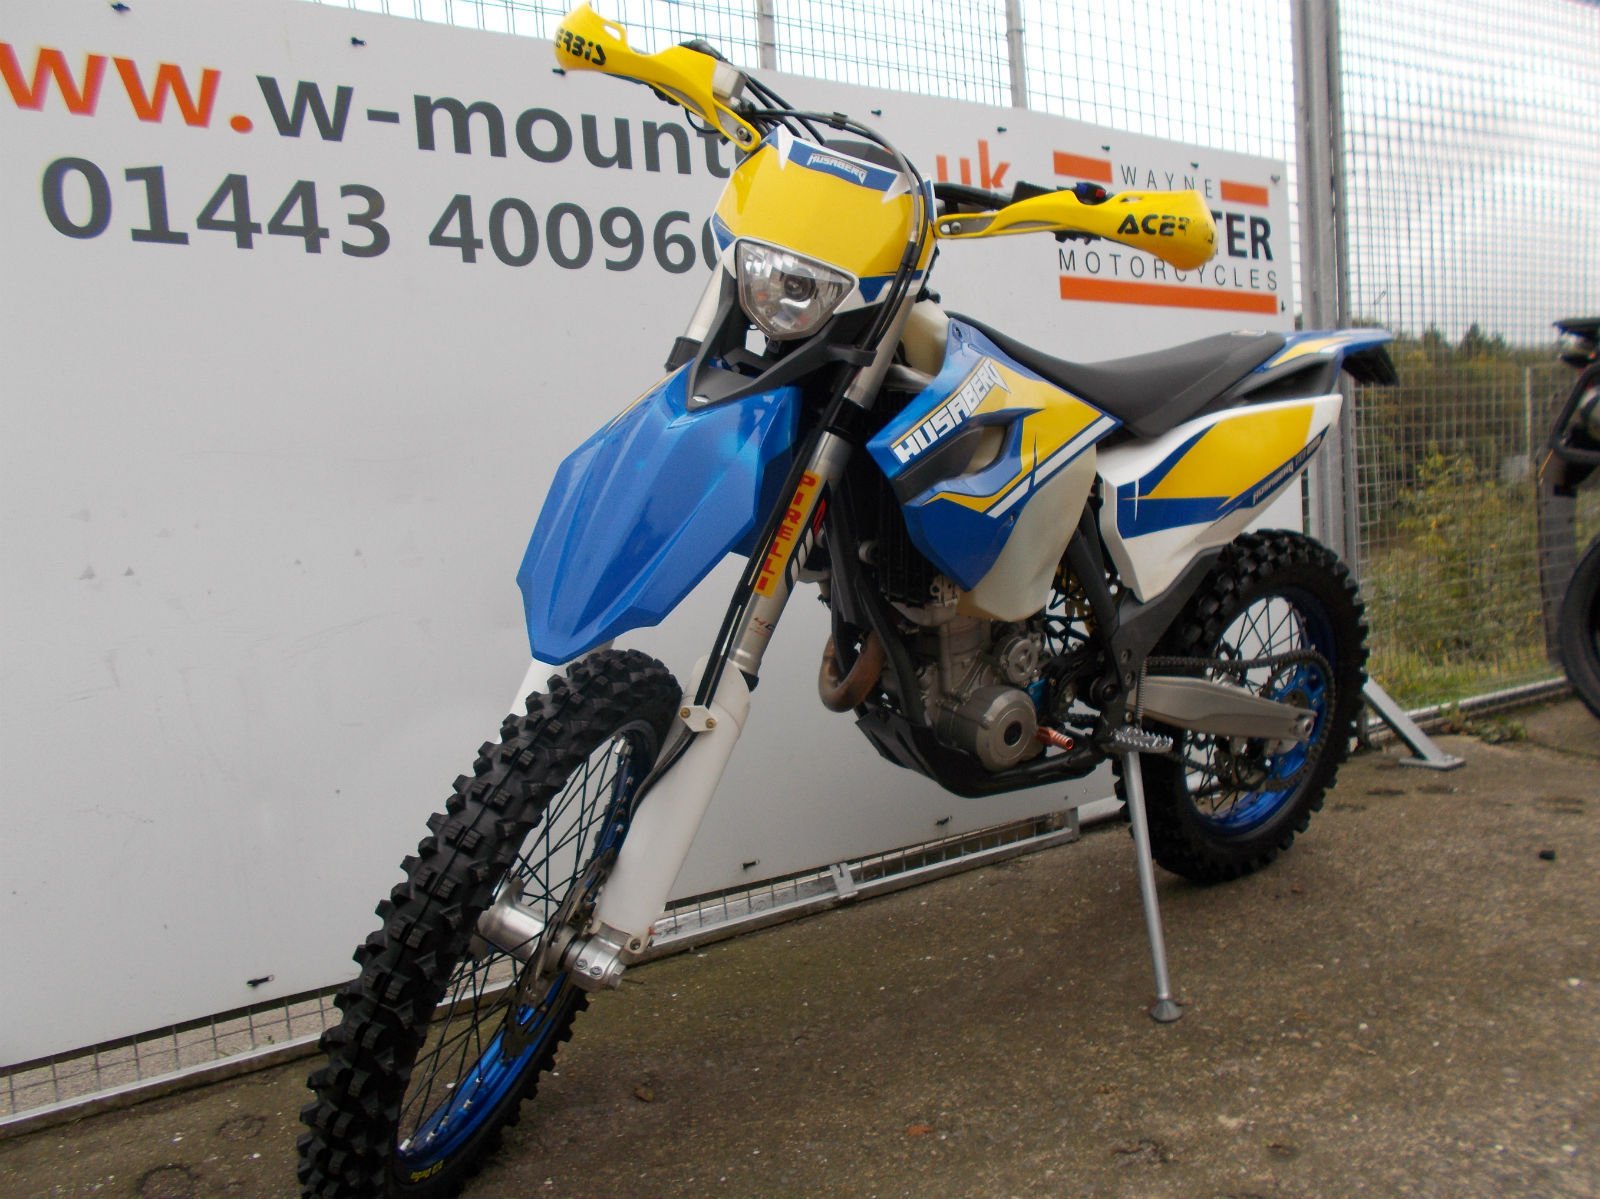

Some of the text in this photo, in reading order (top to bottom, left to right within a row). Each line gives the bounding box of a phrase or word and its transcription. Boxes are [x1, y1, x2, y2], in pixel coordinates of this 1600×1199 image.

[0, 41, 746, 178] ww.w-mount
[41, 157, 390, 258] 01443
[1120, 164, 1213, 198] WAYNE
[893, 356, 1011, 464] HUSABERG
[758, 474, 816, 591] PIRELLI
